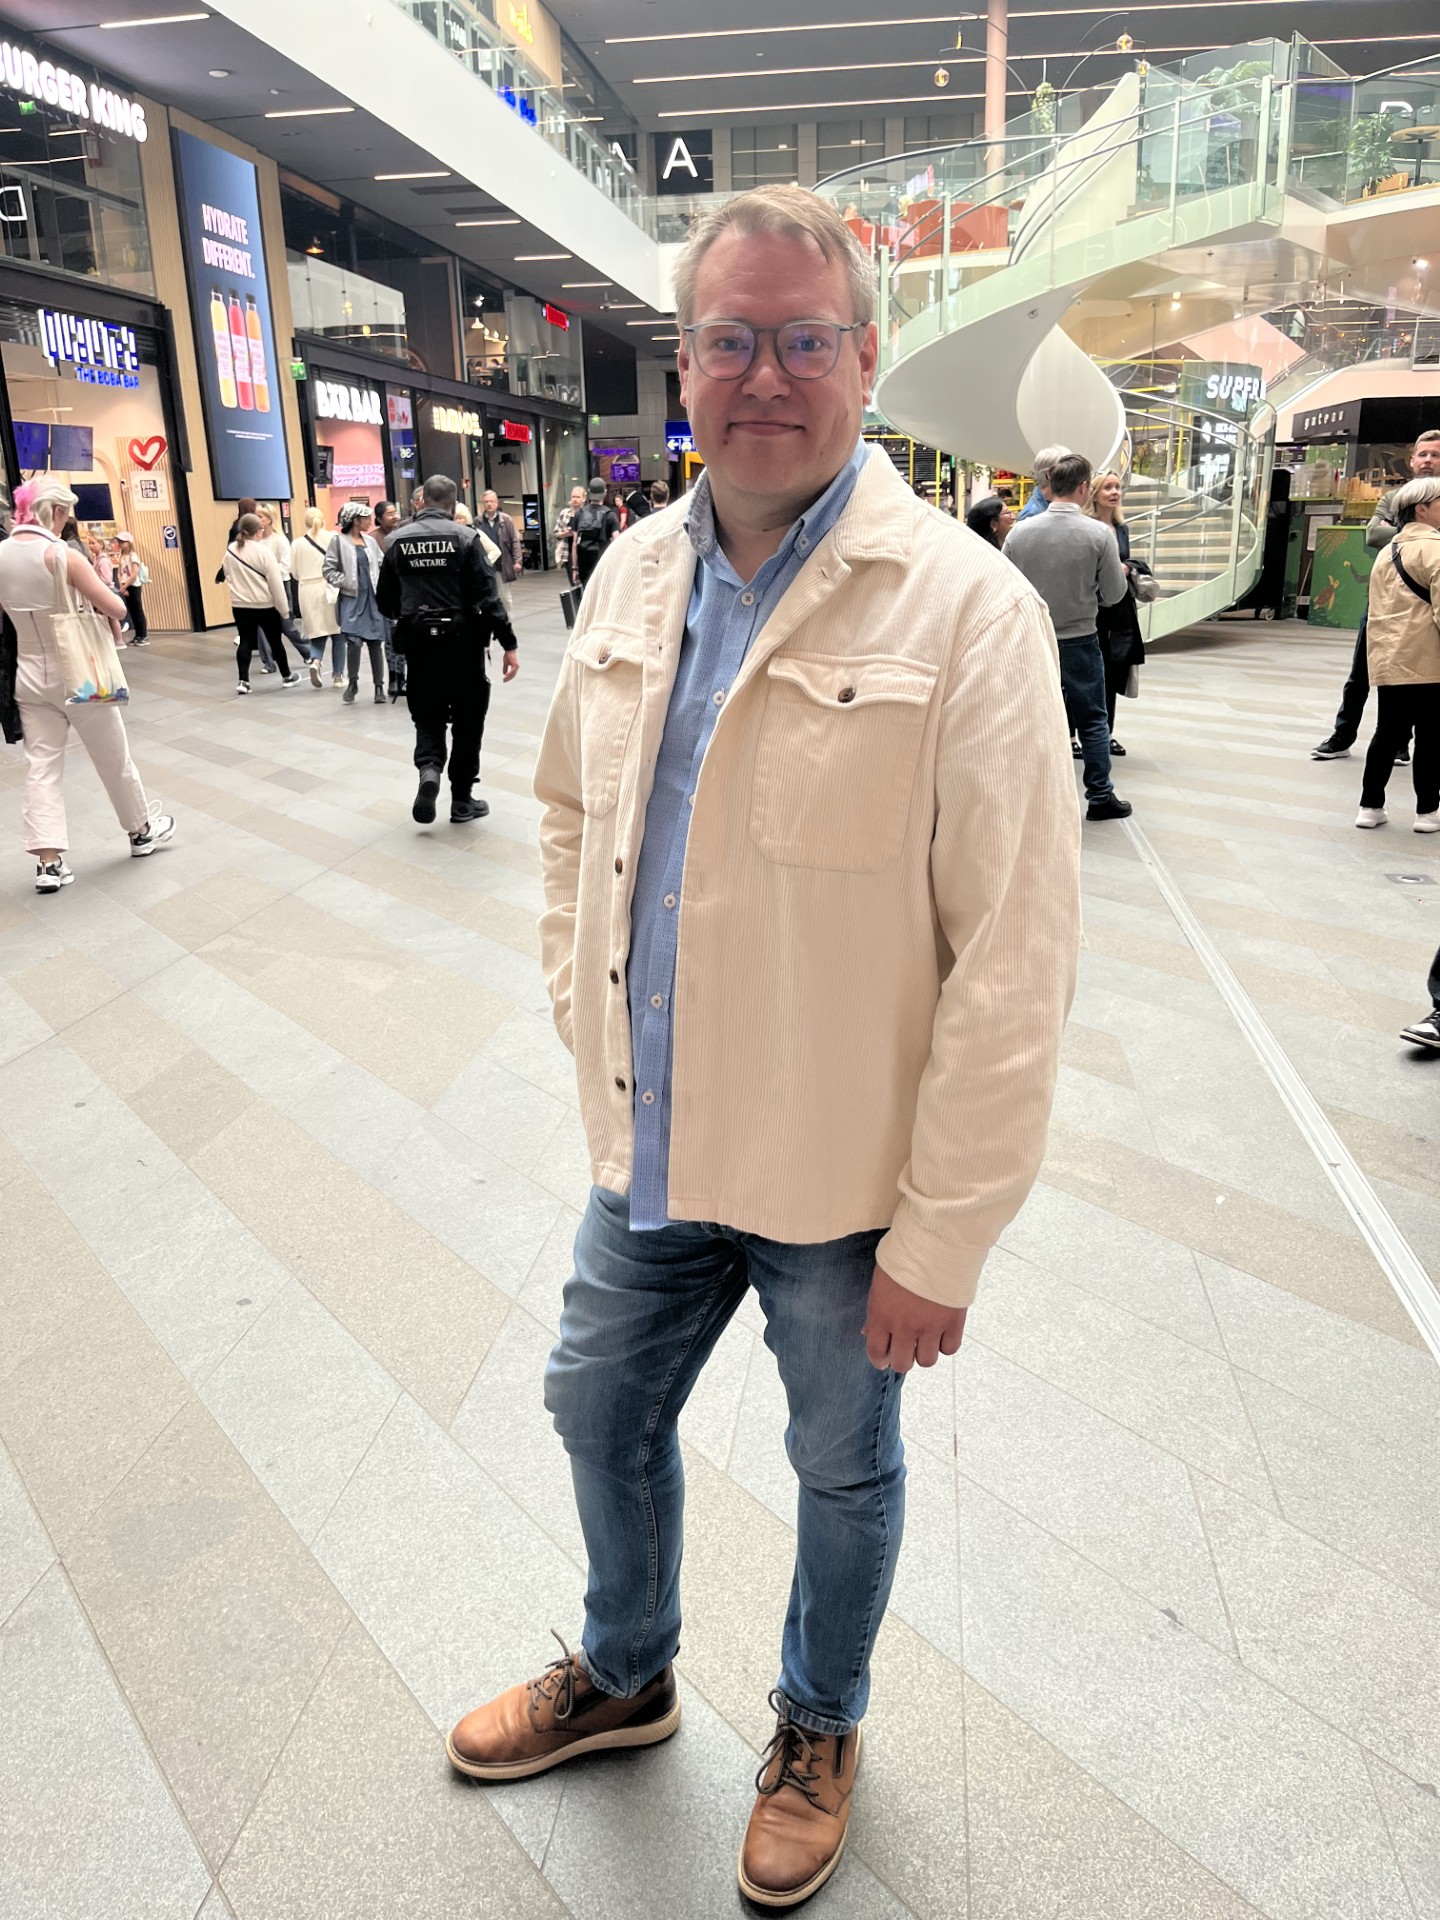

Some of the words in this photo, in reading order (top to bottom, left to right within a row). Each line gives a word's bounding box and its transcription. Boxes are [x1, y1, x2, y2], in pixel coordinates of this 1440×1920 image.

[91, 83, 148, 142] KING
[662, 137, 699, 180] A
[202, 203, 249, 245] HYDRATE
[202, 237, 256, 279] DIFFERENT.
[75, 367, 96, 384] THE
[96, 370, 121, 387] BOBA
[121, 374, 139, 389] BAR
[1304, 410, 1344, 430] gateau
[333, 464, 360, 475] elcome
[400, 541, 456, 556] VARTIJA
